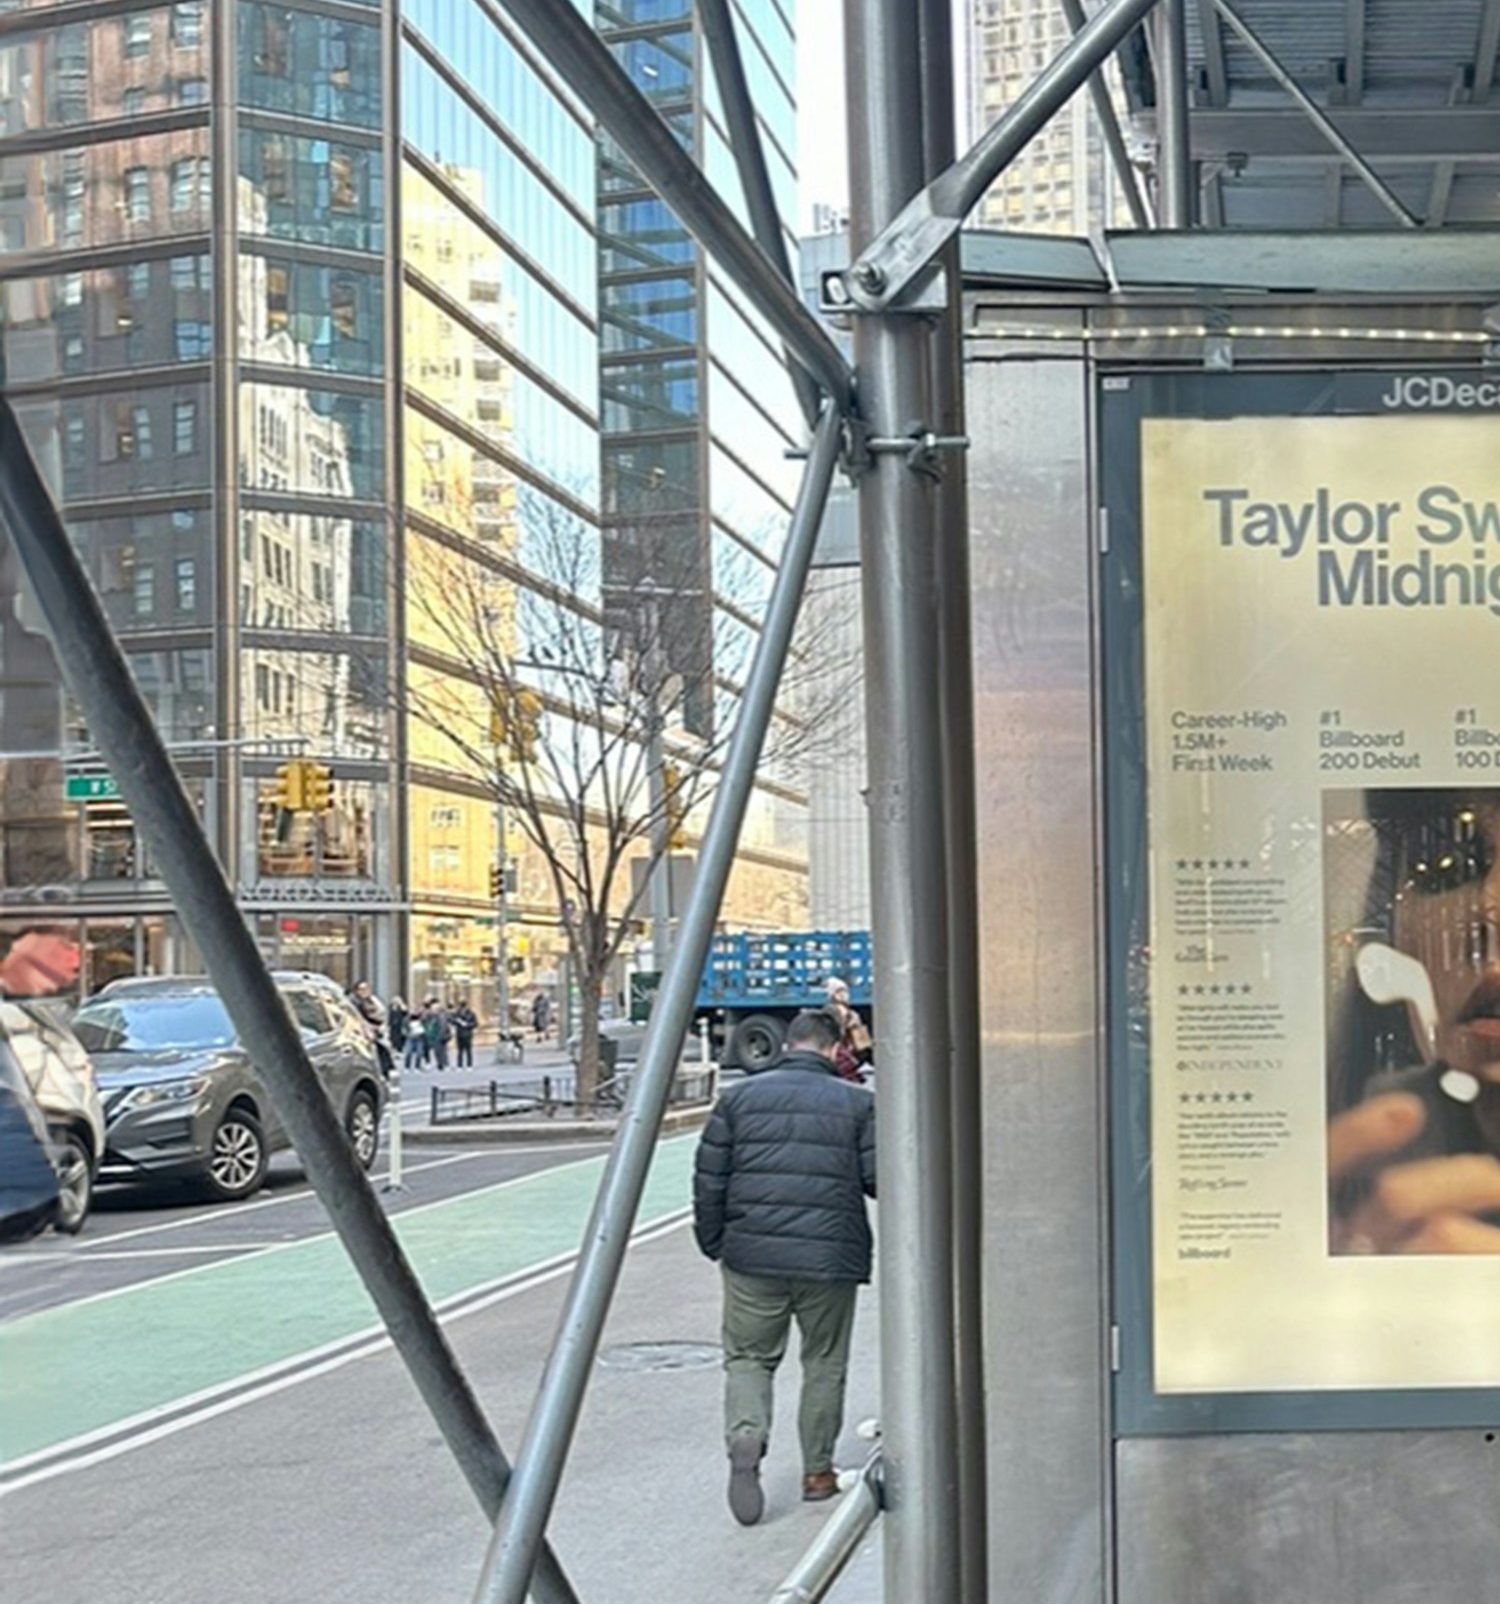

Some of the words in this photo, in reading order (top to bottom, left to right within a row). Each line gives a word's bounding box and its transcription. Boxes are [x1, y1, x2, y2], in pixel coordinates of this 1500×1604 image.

[1202, 487, 1402, 556] Taylor
[1171, 710, 1287, 732] Career-High
[1319, 709, 1342, 726] #1
[1454, 708, 1477, 725] #1
[1173, 733, 1227, 750] 1.5M+
[1319, 730, 1404, 748] Billboard
[1172, 754, 1216, 771] First
[1218, 754, 1273, 772] Week
[1320, 752, 1360, 770] 200
[1362, 751, 1421, 770] Debut
[1456, 751, 1491, 768] 100
